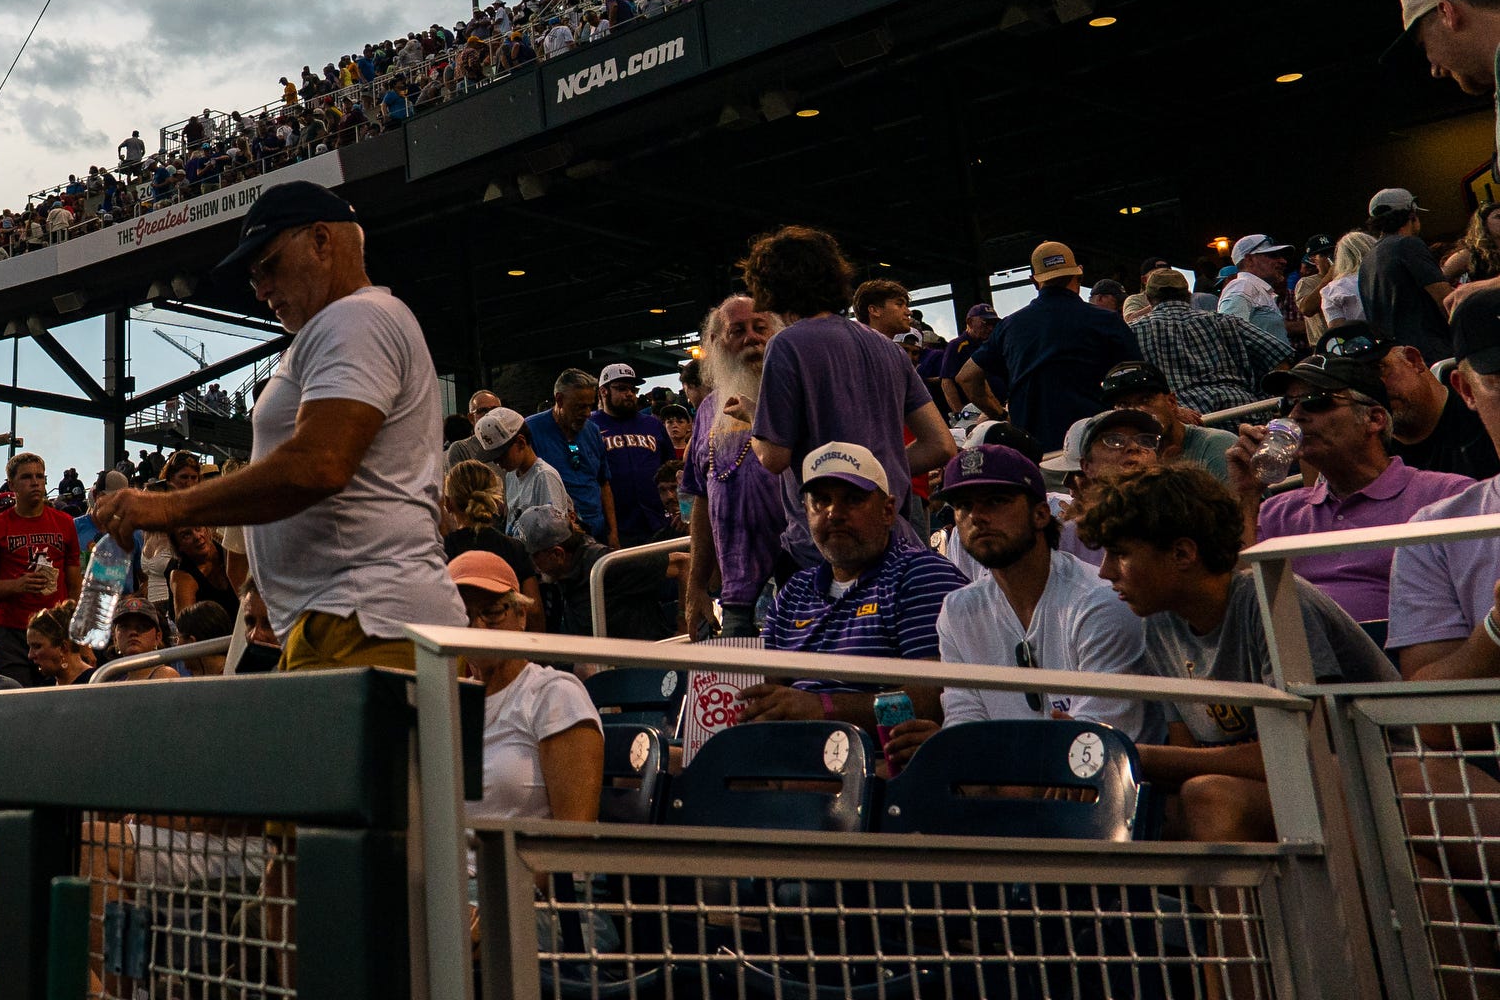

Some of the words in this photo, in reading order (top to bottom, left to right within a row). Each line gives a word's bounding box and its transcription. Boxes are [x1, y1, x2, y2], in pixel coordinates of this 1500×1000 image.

[556, 36, 685, 104] NCAA.com
[117, 227, 136, 246] THE
[133, 204, 190, 246] Greatest
[189, 201, 220, 222] SHOW
[221, 195, 236, 212] ON
[238, 184, 263, 207] DIRT
[810, 451, 862, 472] LOUISIANA
[7, 535, 27, 553] RED
[29, 533, 64, 553] DEVILS
[856, 603, 879, 617] LSU
[693, 672, 718, 693] fresh
[833, 744, 840, 758] 4
[1081, 746, 1092, 764] 5
